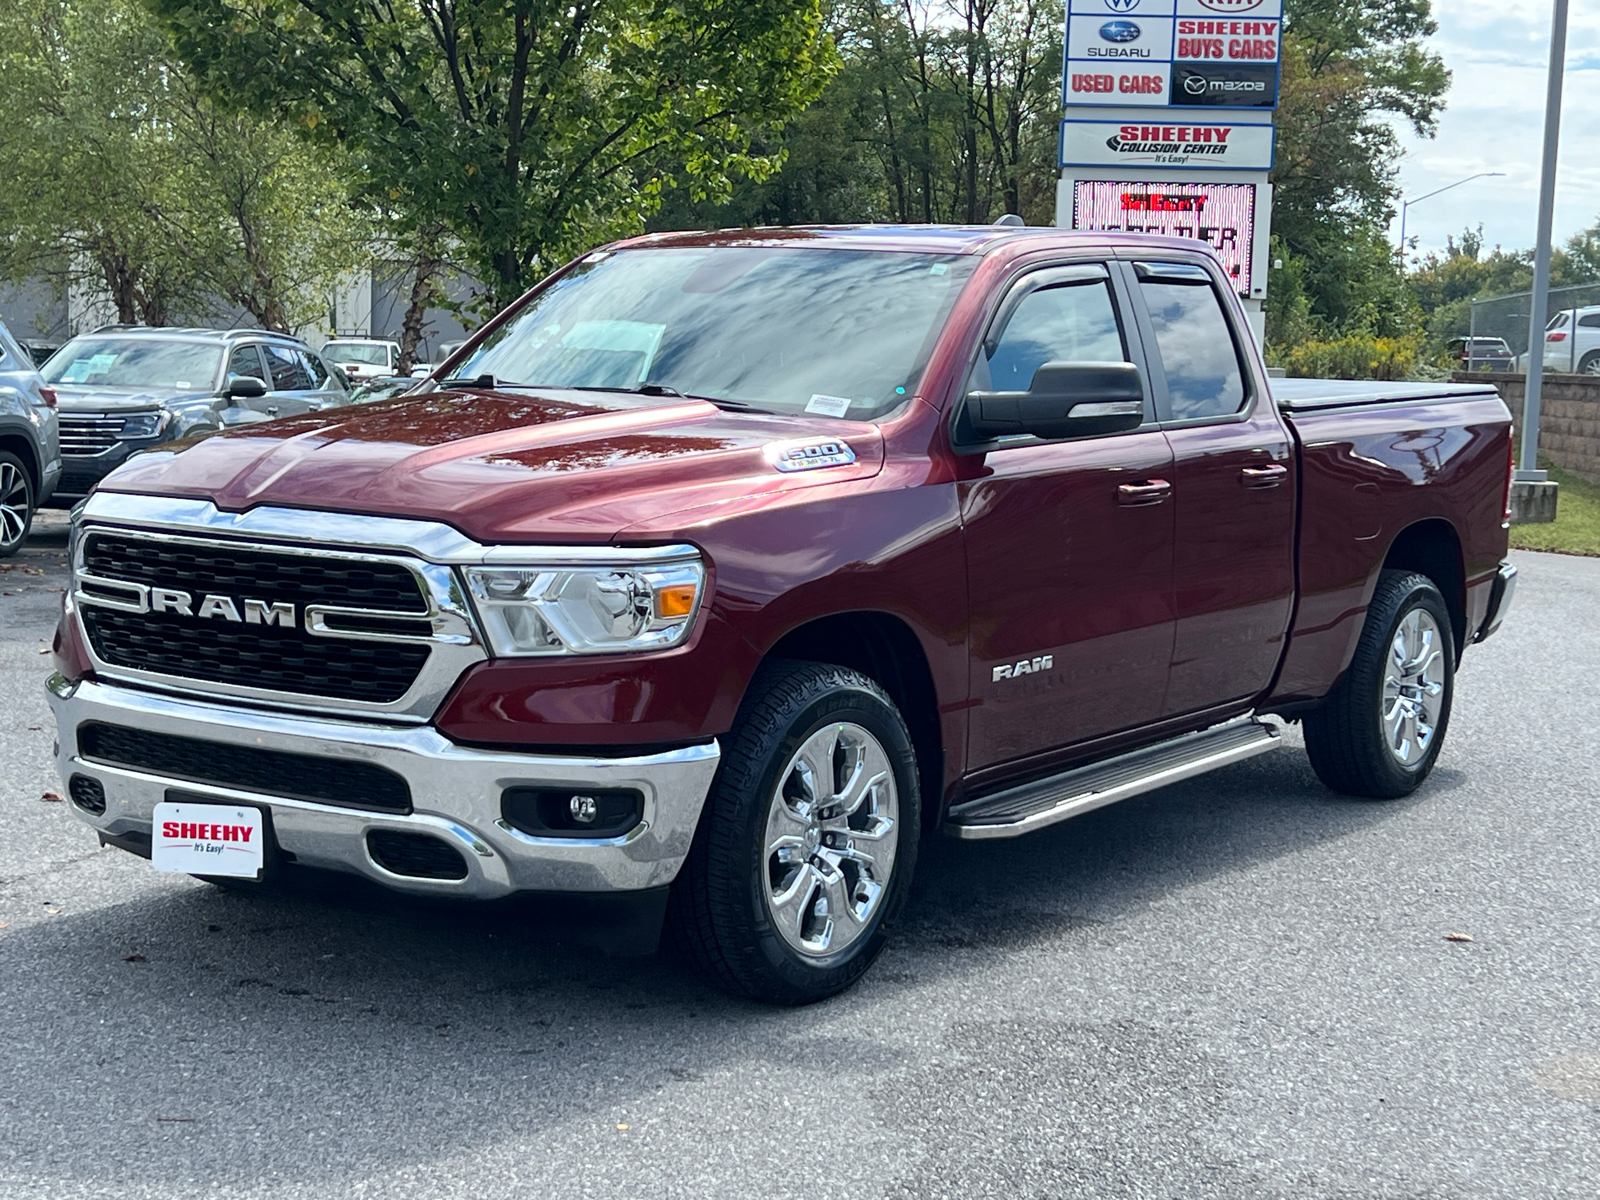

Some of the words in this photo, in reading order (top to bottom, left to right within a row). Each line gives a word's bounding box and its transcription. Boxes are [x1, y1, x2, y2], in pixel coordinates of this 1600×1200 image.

[1178, 21, 1277, 35] SHEEHY
[1087, 47, 1150, 57] SUBARU
[1177, 38, 1224, 58] BUYS
[1228, 39, 1276, 59] CARS
[1072, 74, 1114, 93] USED
[1119, 75, 1163, 94] CARS
[1120, 126, 1232, 142] SHEEHY
[1119, 143, 1181, 153] COLLISION
[1182, 144, 1228, 154] CENTER
[1155, 154, 1167, 163] It's
[1168, 155, 1190, 164] Easy!
[151, 586, 296, 628] RAM
[992, 654, 1054, 682] RAM
[162, 821, 253, 842] SHEEHY
[194, 843, 204, 852] It's
[206, 843, 224, 855] Easy!
